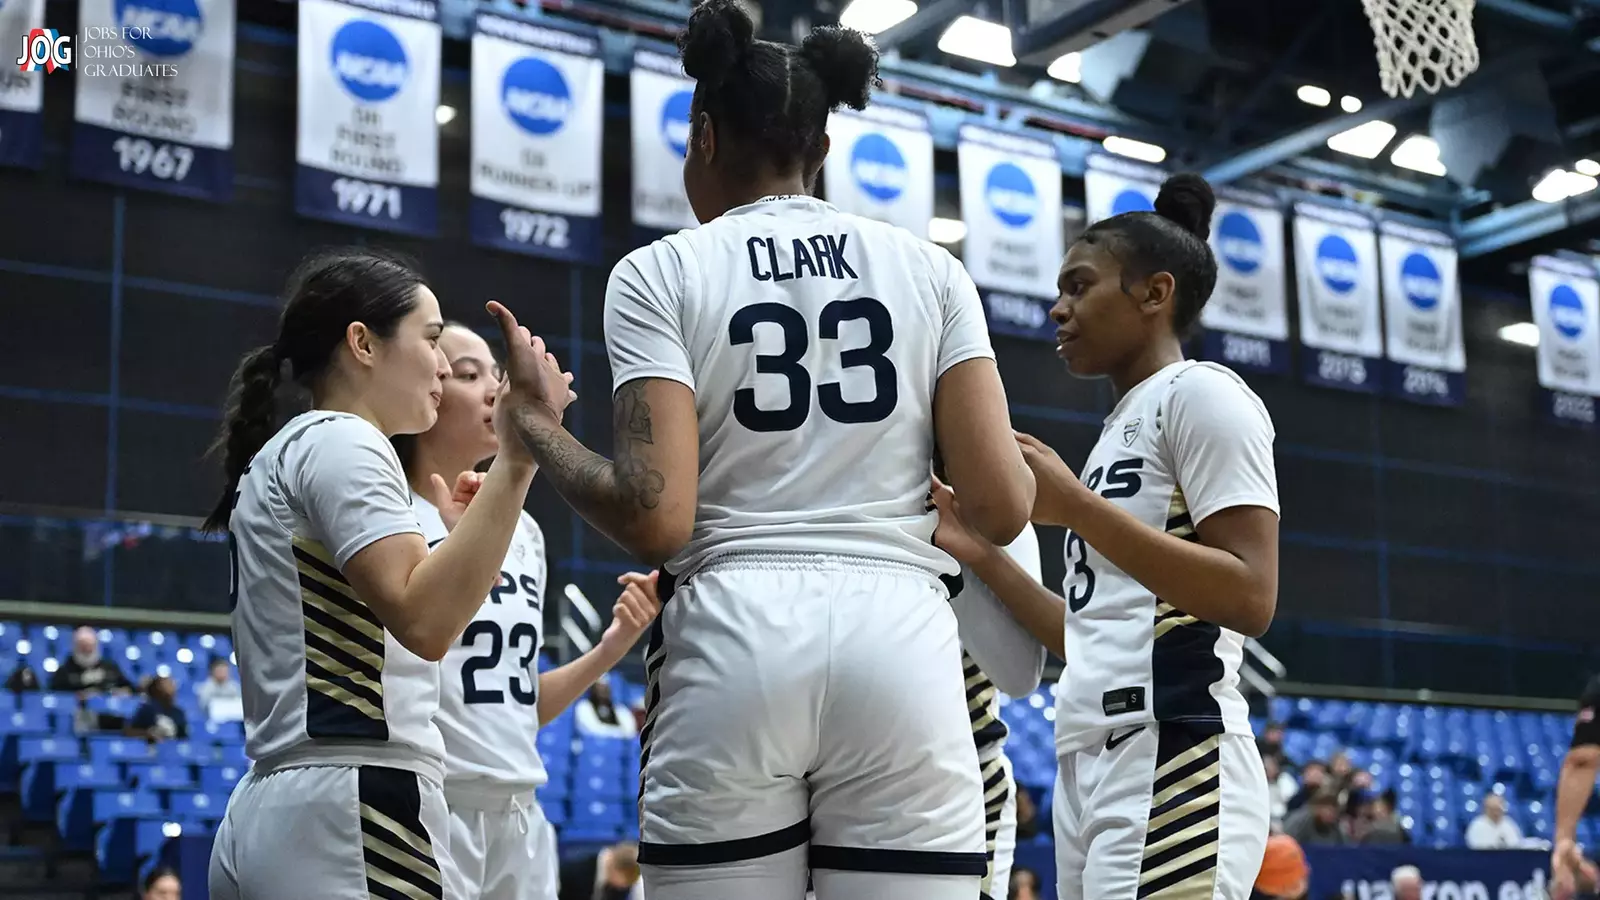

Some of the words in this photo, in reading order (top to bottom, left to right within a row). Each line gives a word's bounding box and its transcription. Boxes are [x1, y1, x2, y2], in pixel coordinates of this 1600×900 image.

[335, 49, 409, 88] NCAA
[504, 86, 570, 122] NCAA
[113, 136, 194, 181] 1967
[332, 177, 402, 219] 1971
[500, 206, 570, 249] 1972
[747, 233, 858, 282] CLARK
[729, 297, 898, 432] 33
[1085, 457, 1143, 499] PS
[460, 620, 538, 705] 23
